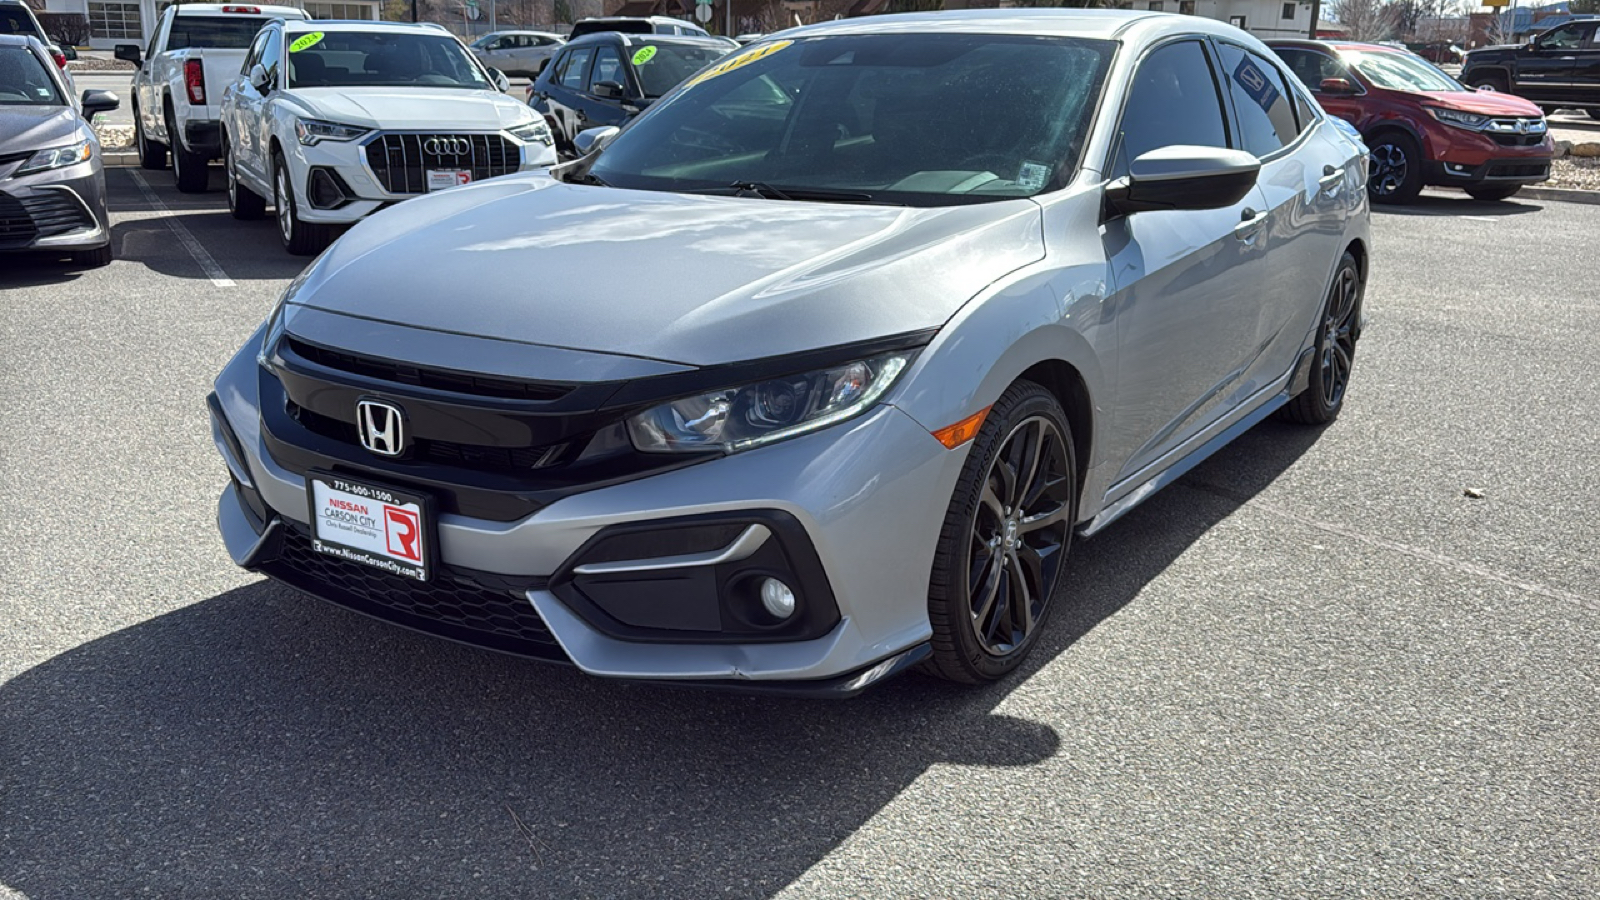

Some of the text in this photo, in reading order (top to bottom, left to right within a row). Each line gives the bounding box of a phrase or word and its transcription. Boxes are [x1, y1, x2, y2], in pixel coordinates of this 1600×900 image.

[293, 33, 319, 50] 2024
[334, 480, 392, 502] 775-600-1500
[329, 498, 368, 515] NISSAN
[324, 507, 376, 528] CARSON CITY
[353, 526, 377, 539] Dealership
[322, 544, 416, 576] www.NissanCarsonCity.com
